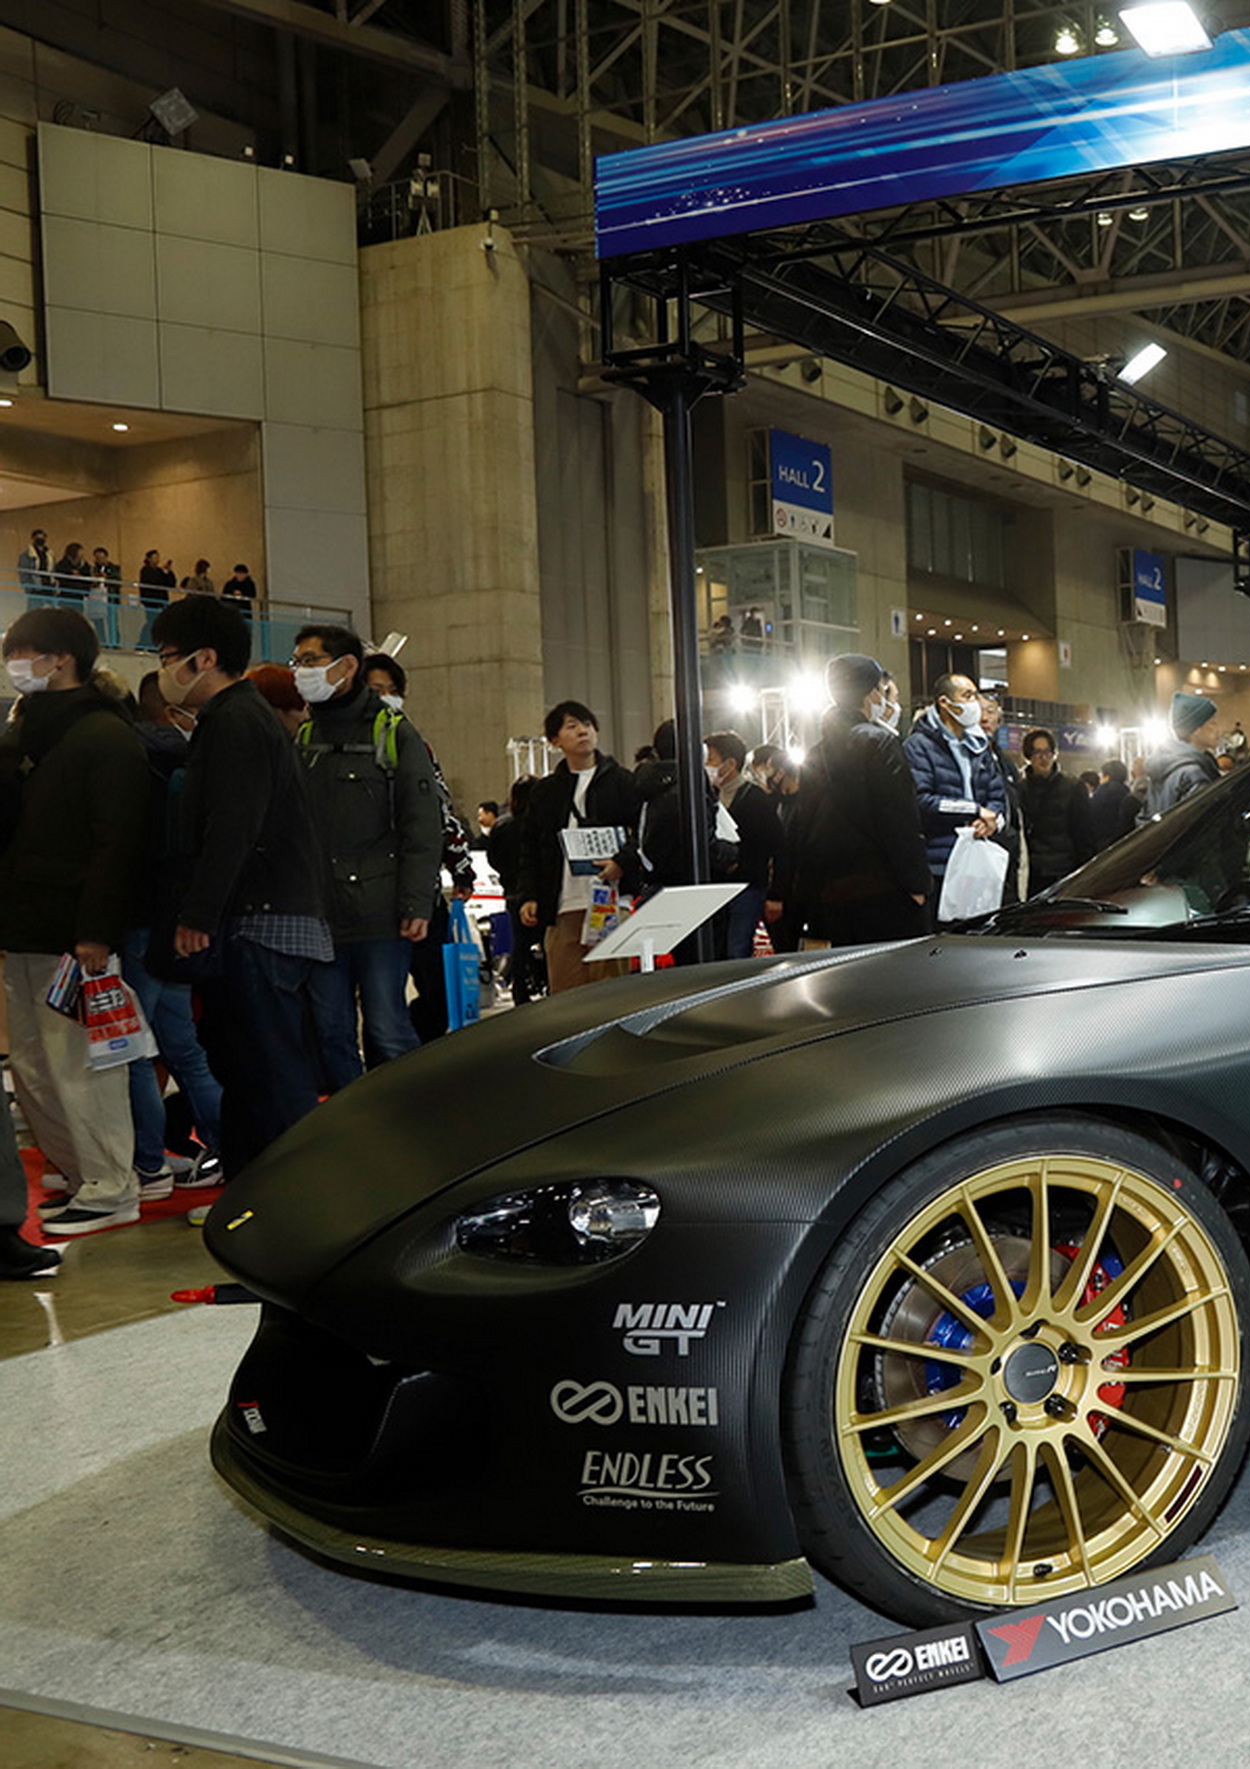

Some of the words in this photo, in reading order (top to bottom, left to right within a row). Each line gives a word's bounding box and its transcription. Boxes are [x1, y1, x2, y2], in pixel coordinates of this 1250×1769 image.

[778, 465, 810, 489] HALL
[812, 460, 826, 493] 2
[1153, 566, 1162, 591] 2
[612, 1303, 714, 1328] MINI
[623, 1329, 705, 1356] GT
[627, 1386, 719, 1426] ENKEI
[581, 1450, 713, 1490] ENDLESS
[583, 1495, 638, 1510] Challenge
[640, 1499, 653, 1509] to
[655, 1500, 675, 1510] the
[677, 1500, 715, 1512] Future
[1047, 1571, 1225, 1643] YOKOHAMA
[914, 1635, 970, 1671] ENKEI
